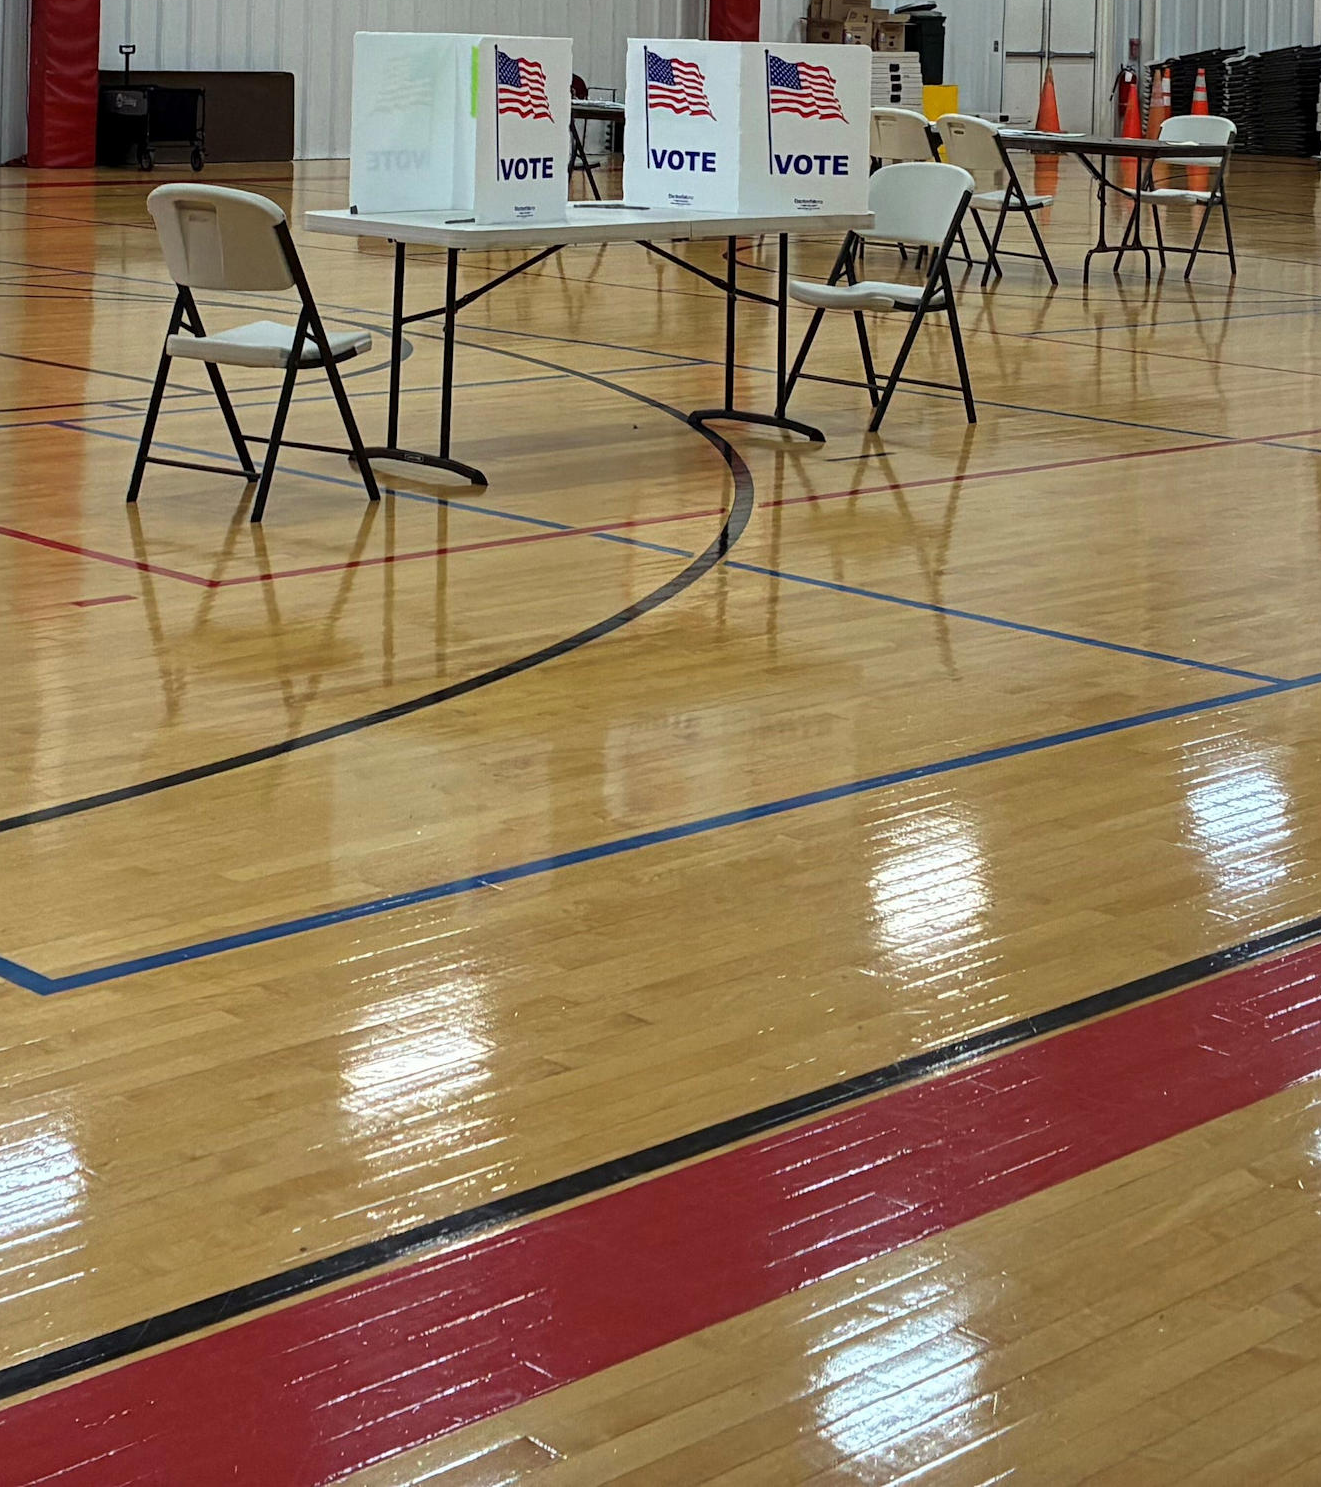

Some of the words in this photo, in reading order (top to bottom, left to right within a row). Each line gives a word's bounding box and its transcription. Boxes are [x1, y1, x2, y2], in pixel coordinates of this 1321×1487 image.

[500, 157, 554, 181] VOTE
[651, 149, 716, 173] VOTE
[774, 154, 849, 175] VOTE
